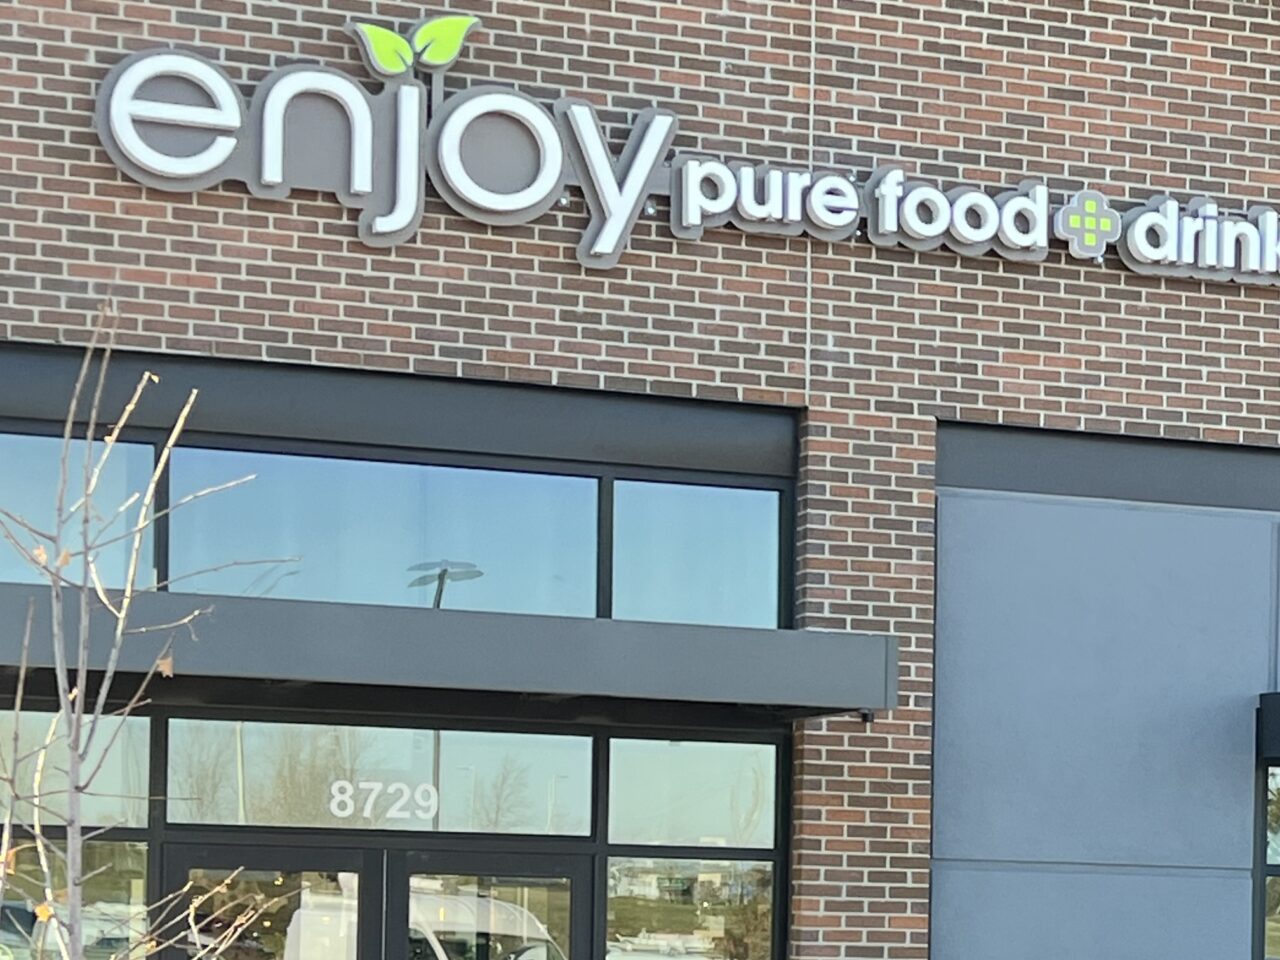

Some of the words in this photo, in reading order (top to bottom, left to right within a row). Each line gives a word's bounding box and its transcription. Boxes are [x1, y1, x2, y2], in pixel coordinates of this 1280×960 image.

[109, 50, 674, 255] enjoy
[681, 158, 860, 230] pure
[874, 168, 1049, 251] food
[329, 779, 439, 820] 8729
